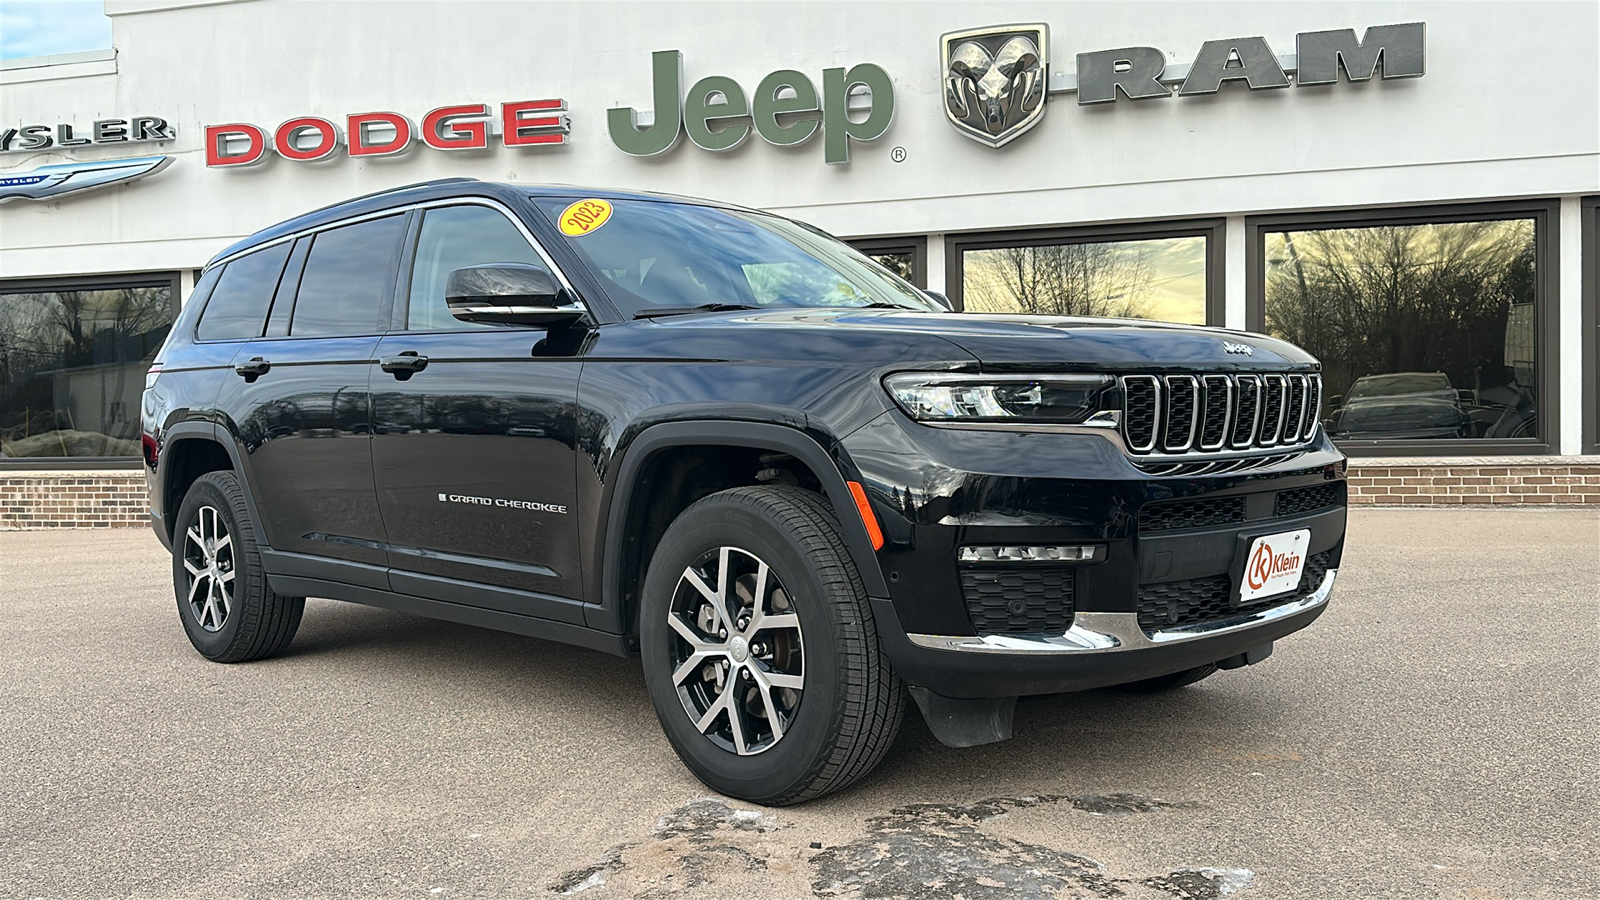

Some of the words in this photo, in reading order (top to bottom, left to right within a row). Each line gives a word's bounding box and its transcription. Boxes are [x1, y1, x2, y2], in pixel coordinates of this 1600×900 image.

[1076, 22, 1427, 105] RAM
[606, 50, 896, 165] Jeep
[204, 98, 569, 168] DODGE
[567, 201, 605, 231] 2023
[1222, 341, 1253, 357] Jeep
[449, 494, 492, 506] GRAND
[495, 499, 567, 514] CHEROKEE
[1272, 551, 1300, 574] Klein
